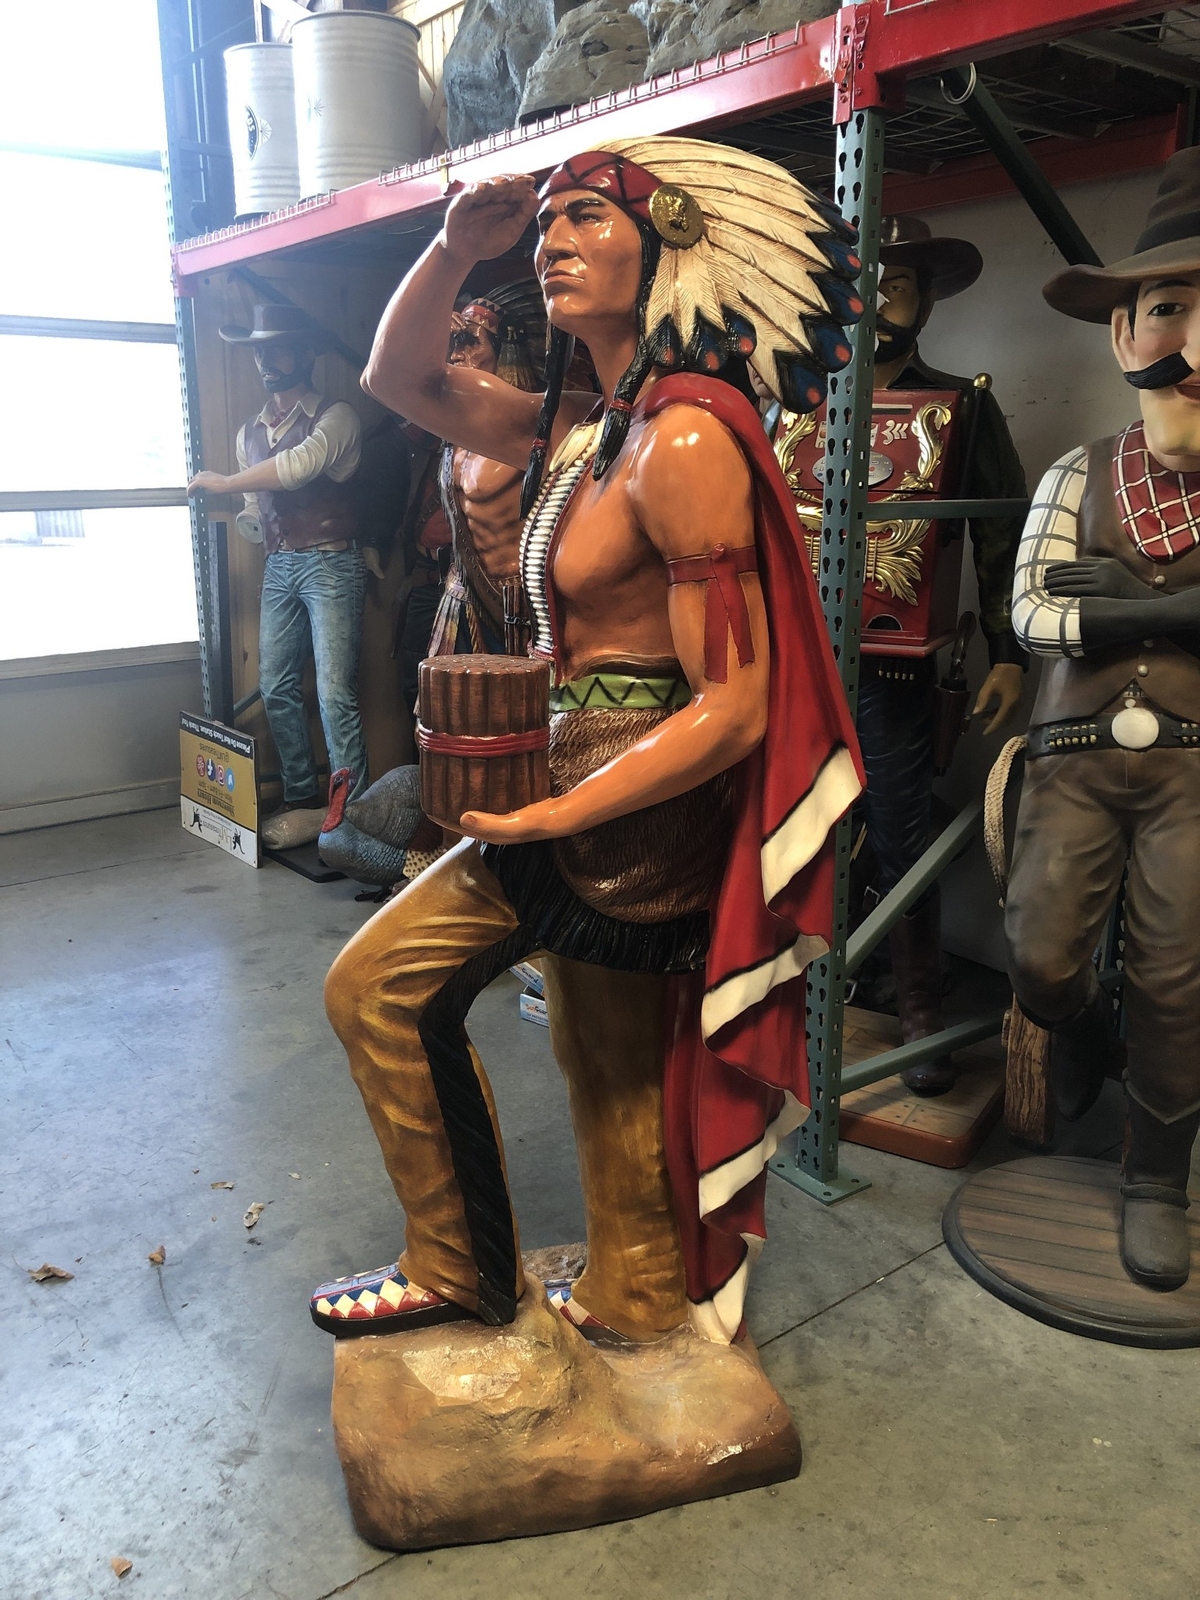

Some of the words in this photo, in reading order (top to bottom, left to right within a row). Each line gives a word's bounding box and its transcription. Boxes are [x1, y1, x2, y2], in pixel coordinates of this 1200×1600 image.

[189, 720, 199, 731] Thank
[213, 730, 223, 742] Touch
[230, 738, 235, 747] Do
[236, 740, 250, 753] Please
[197, 789, 210, 804] Hours
[212, 797, 234, 817] Showroom
[526, 1004, 548, 1014] SunGuar
